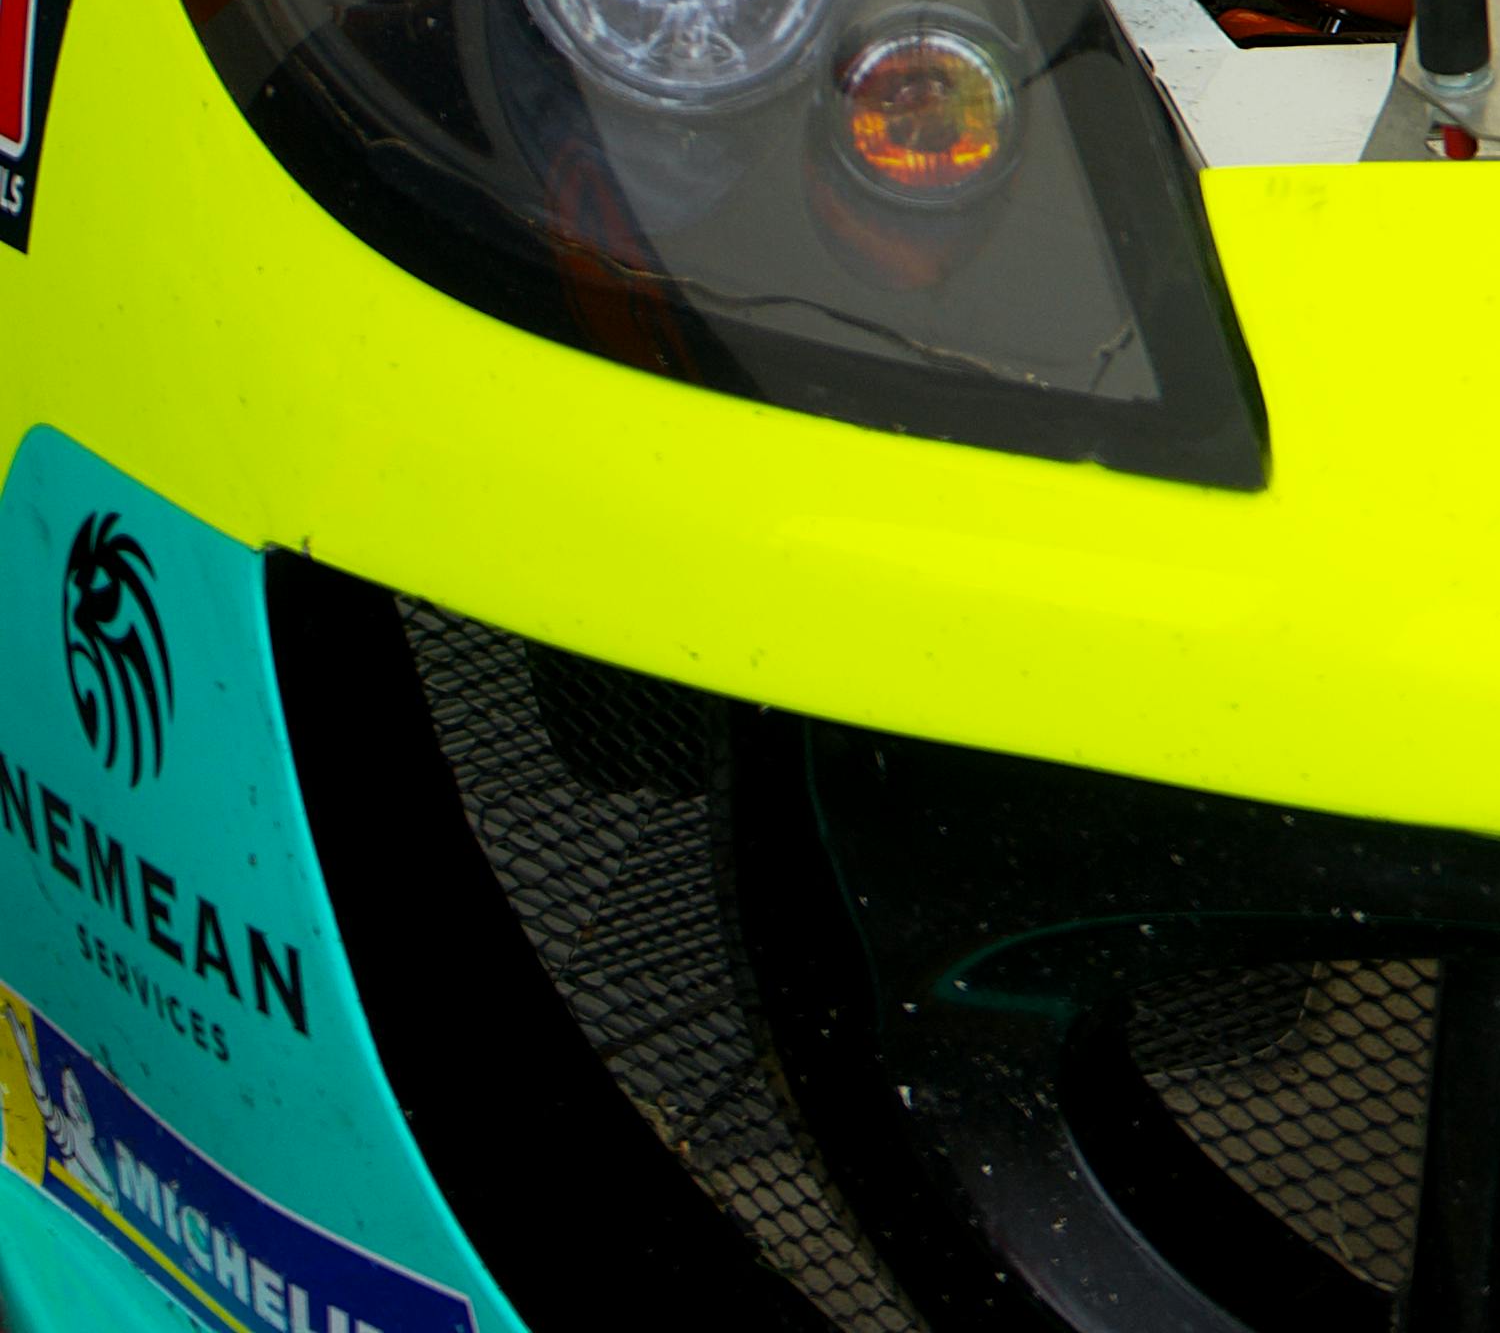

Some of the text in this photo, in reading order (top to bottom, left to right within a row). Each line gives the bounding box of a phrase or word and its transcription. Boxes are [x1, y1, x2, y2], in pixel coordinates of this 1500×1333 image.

[0, 750, 310, 1040] NEMEAN
[76, 921, 231, 1063] SERVICES
[113, 1137, 385, 1333] MICHEL
